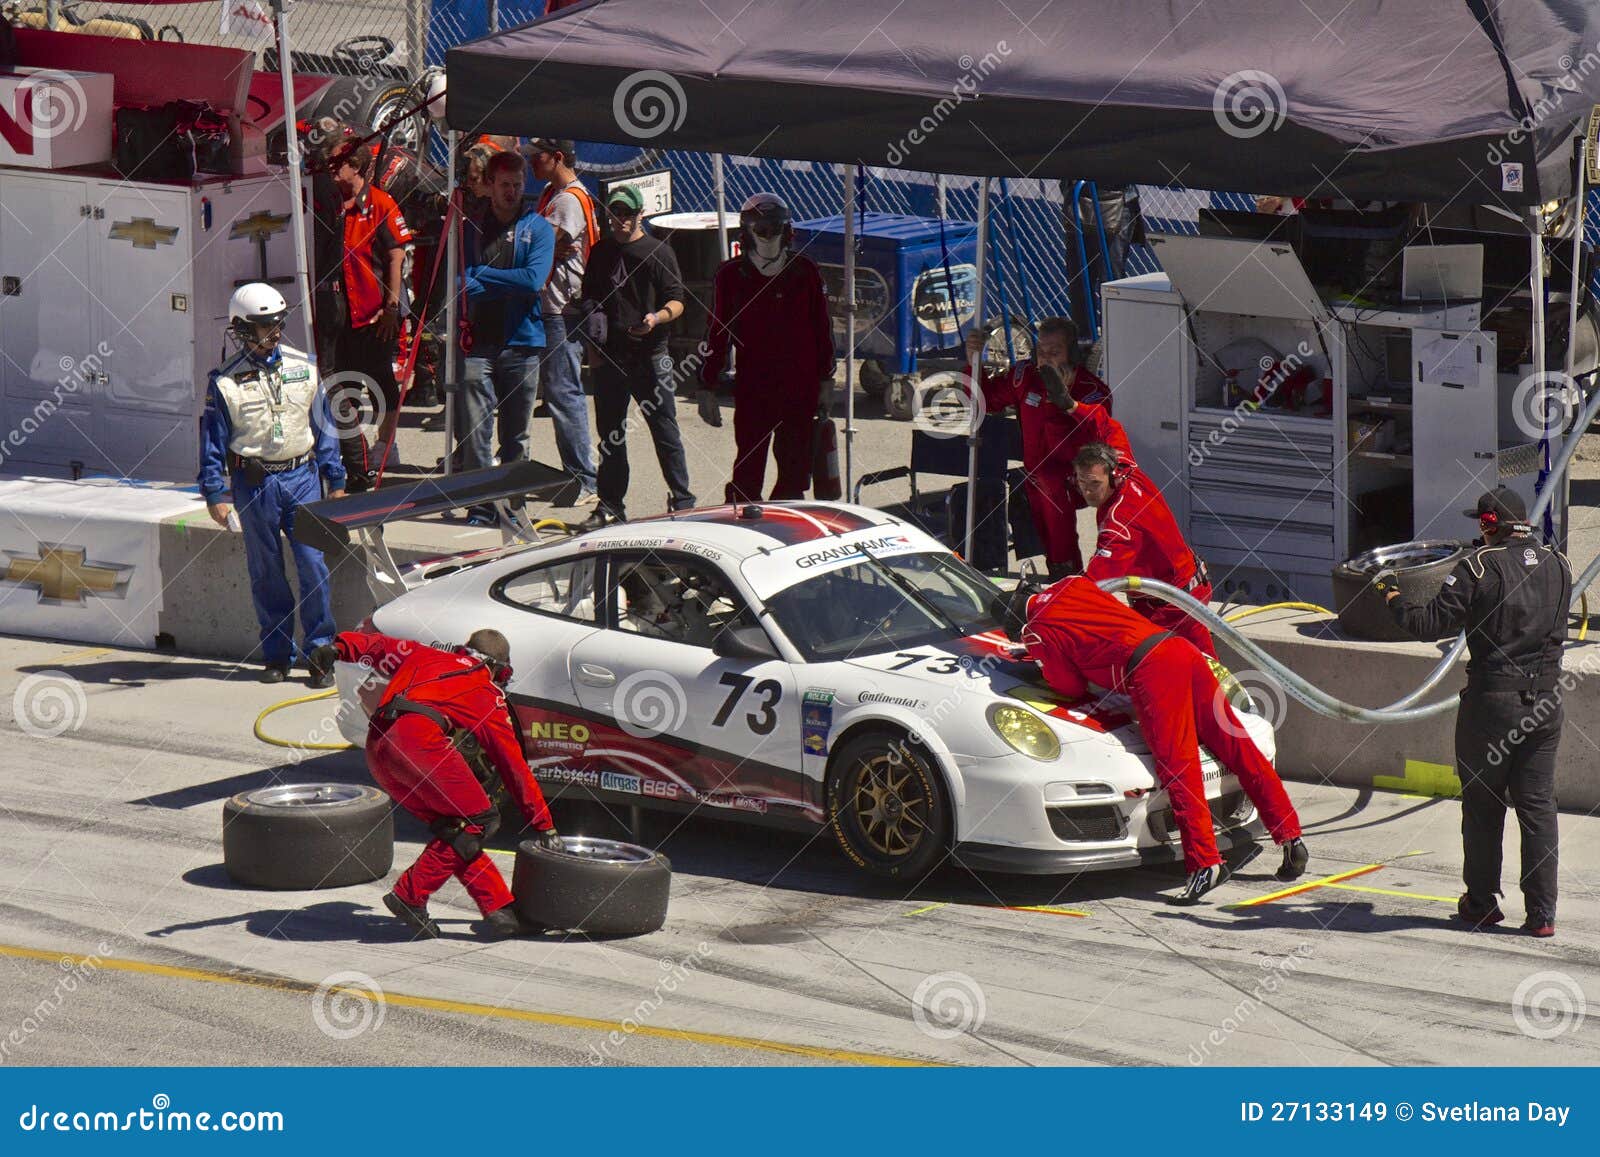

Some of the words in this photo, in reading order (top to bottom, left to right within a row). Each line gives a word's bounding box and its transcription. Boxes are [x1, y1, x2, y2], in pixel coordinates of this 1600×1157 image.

[711, 671, 782, 735] 73
[858, 690, 919, 708] Continental
[531, 721, 590, 743] NEO
[602, 772, 639, 792] Airgas
[643, 780, 679, 797] BBS
